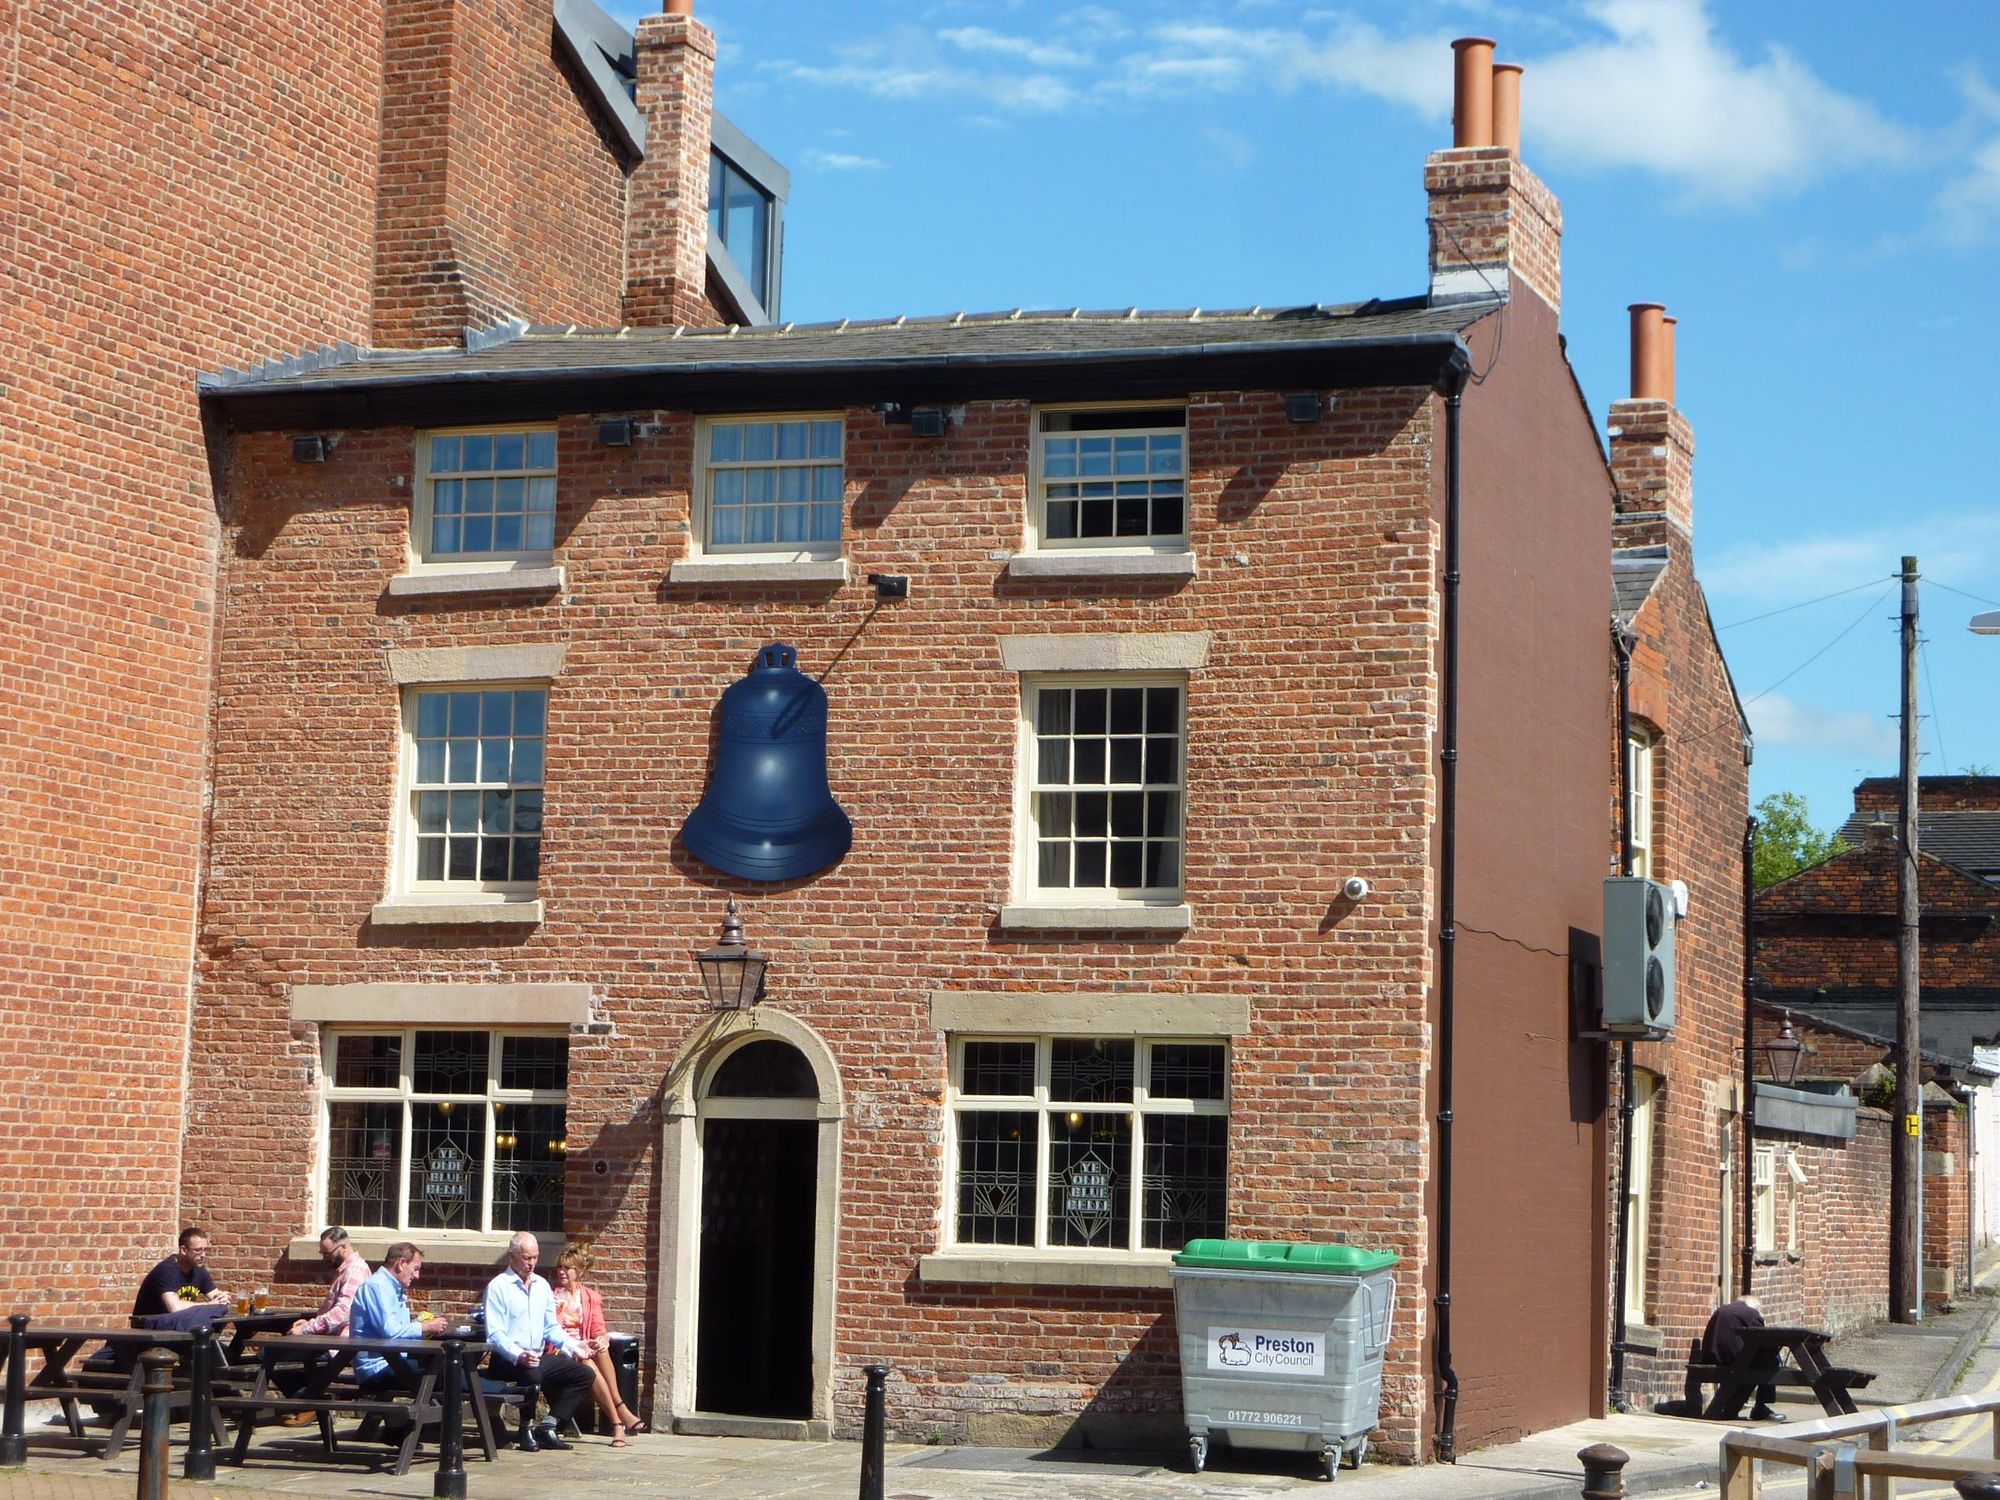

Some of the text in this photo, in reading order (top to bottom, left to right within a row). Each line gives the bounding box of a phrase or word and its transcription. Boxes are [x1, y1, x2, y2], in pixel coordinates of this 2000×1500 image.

[1909, 1117, 1919, 1133] H
[440, 1149, 456, 1159] YE
[1082, 1163, 1100, 1173] YE
[430, 1172, 463, 1182] BLUE
[1071, 1187, 1108, 1197] BLUE
[1255, 1334, 1315, 1354] Preston
[1254, 1353, 1314, 1367] City Council
[1228, 1411, 1303, 1425] 01772 906221
